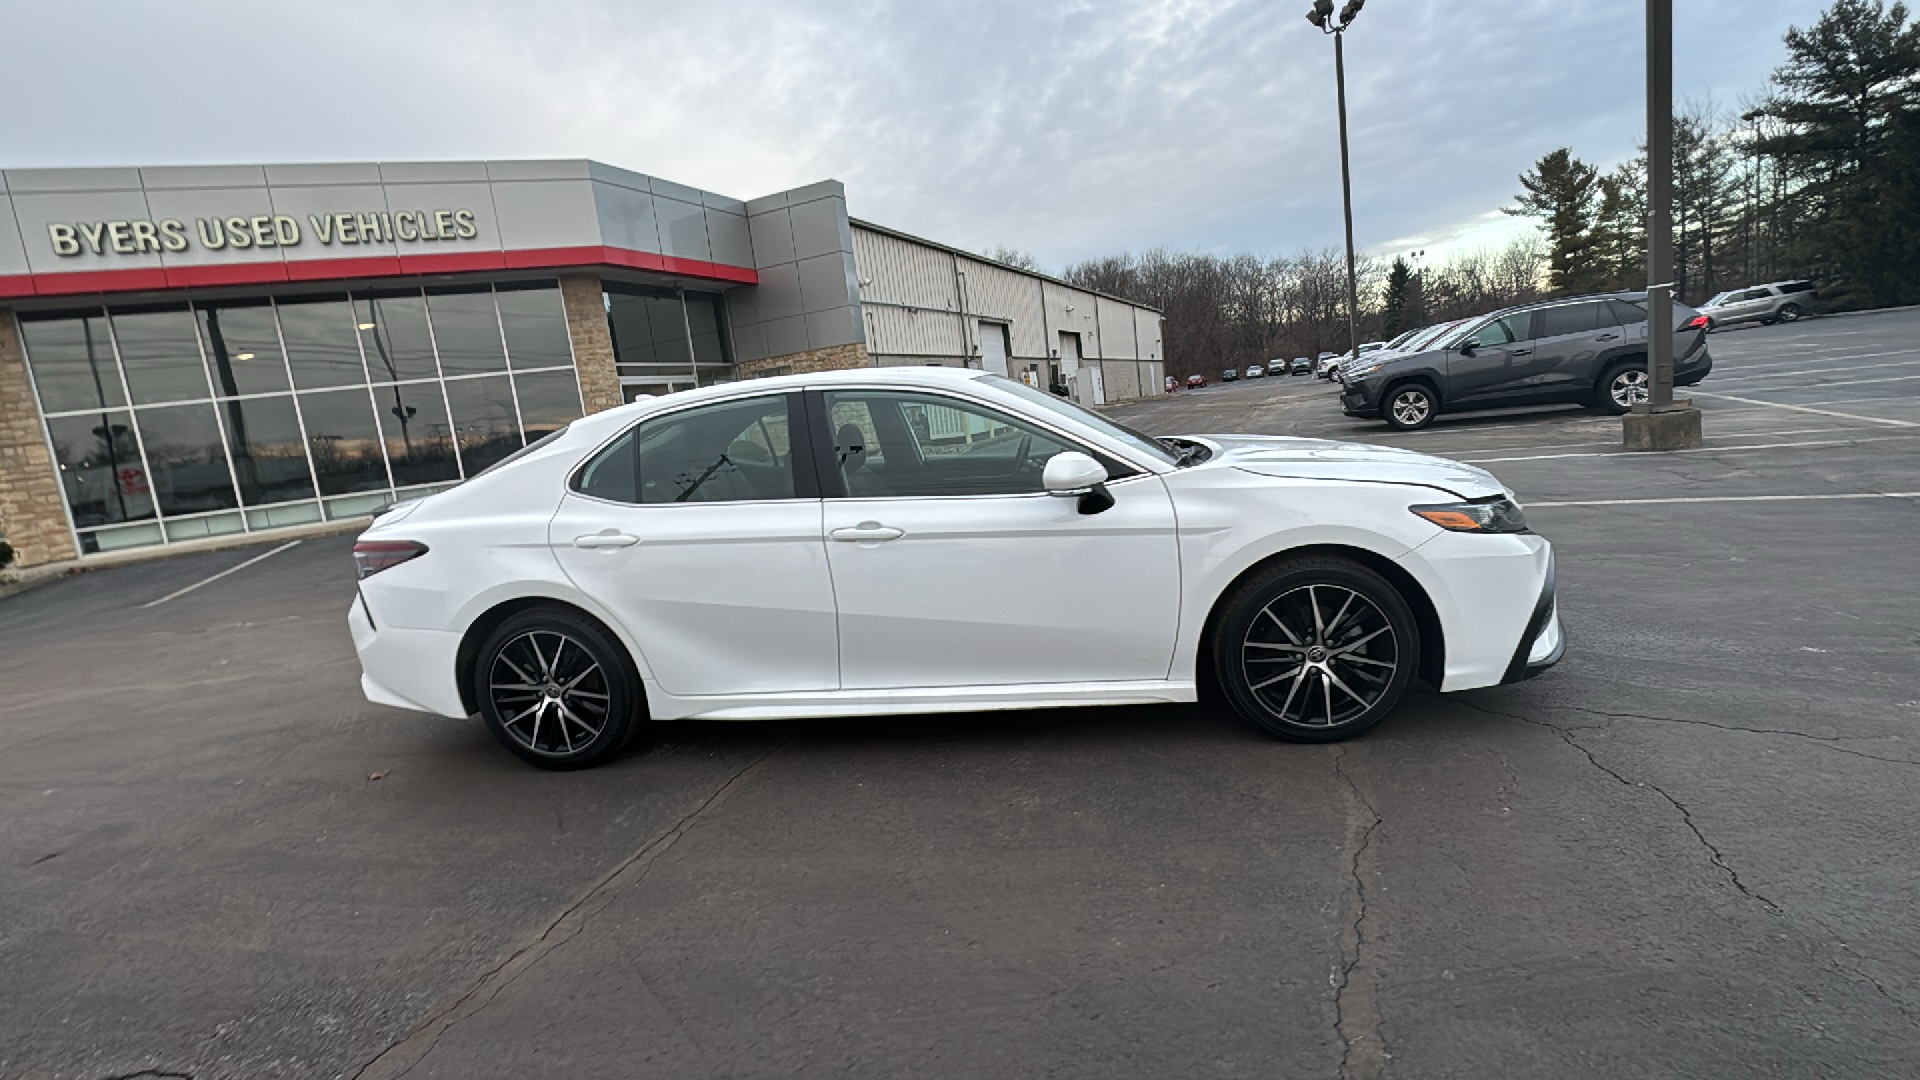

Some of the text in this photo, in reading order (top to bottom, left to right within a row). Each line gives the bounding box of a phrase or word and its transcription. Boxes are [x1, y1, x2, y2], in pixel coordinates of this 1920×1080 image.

[47, 209, 477, 256] BYERS USED VEHICLES
